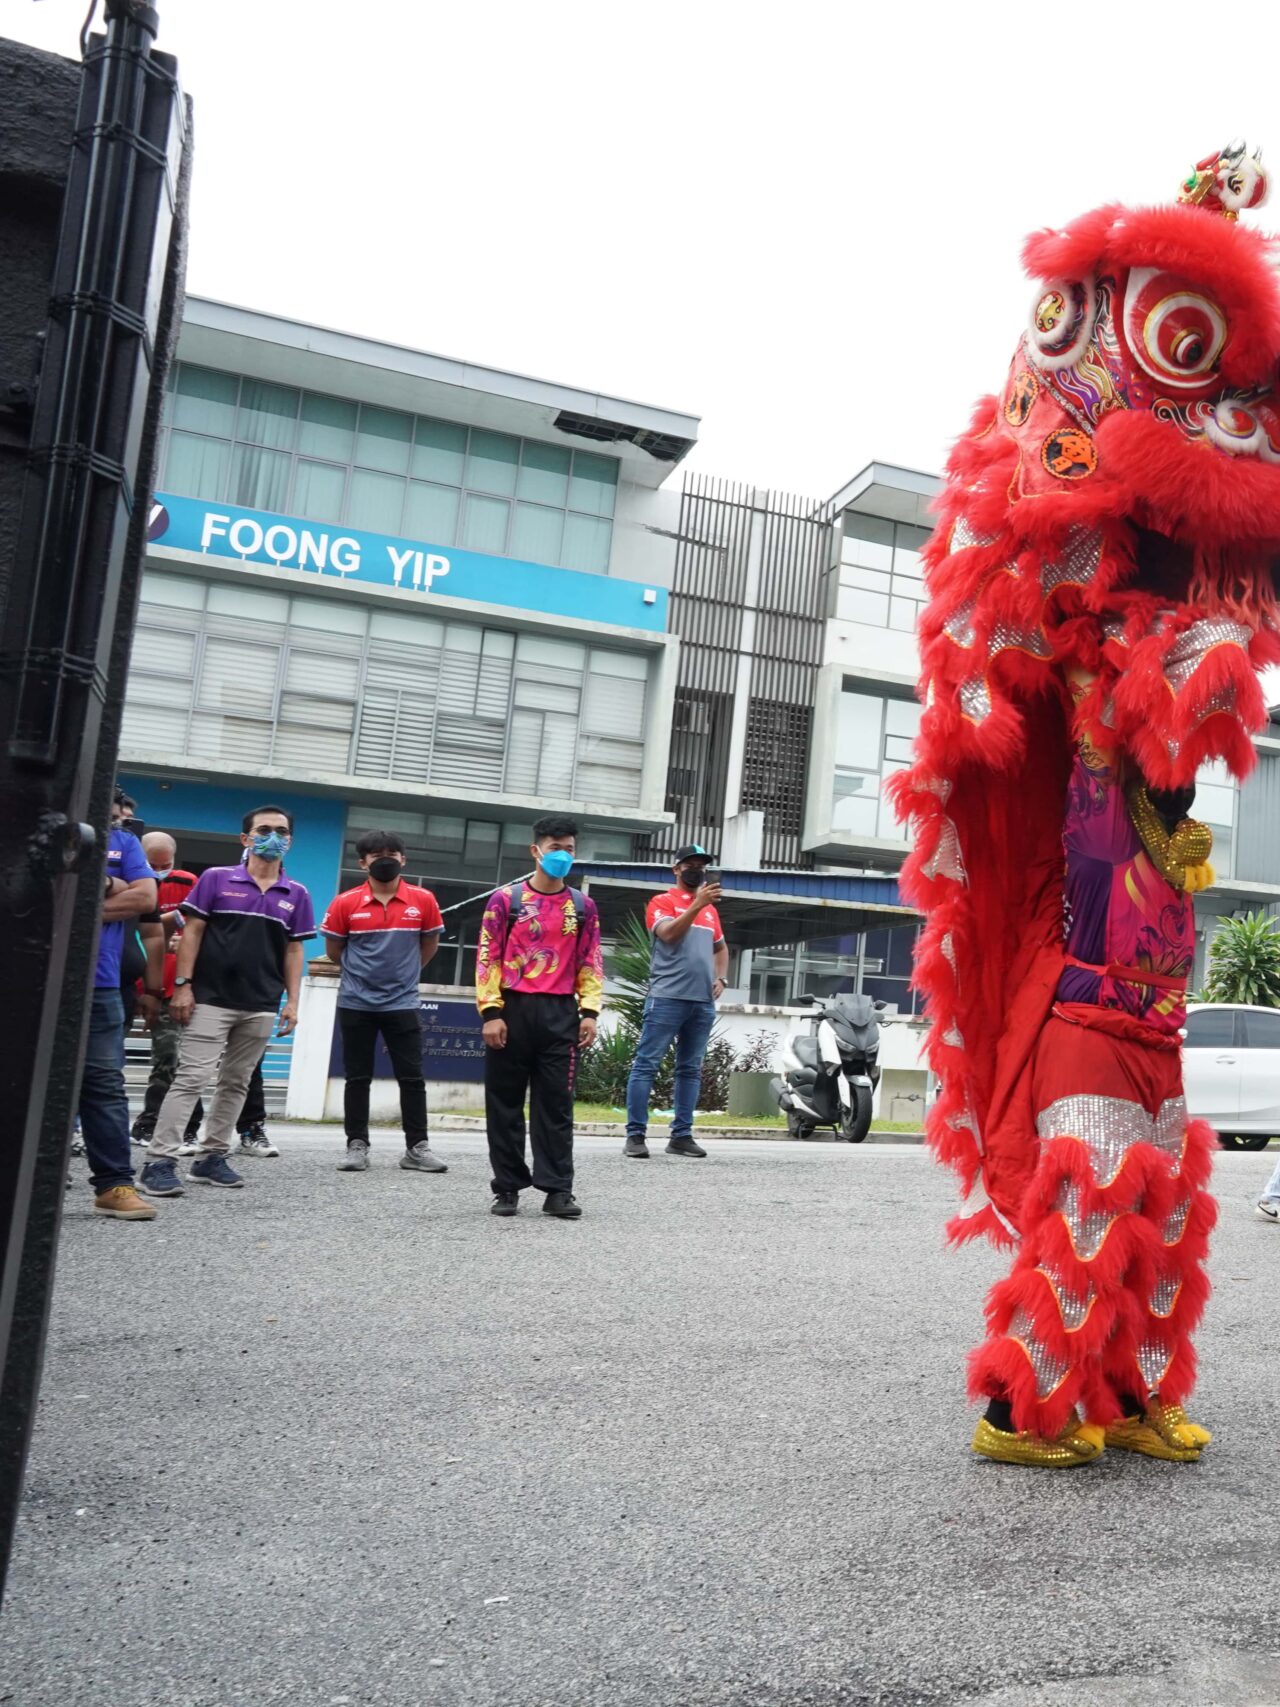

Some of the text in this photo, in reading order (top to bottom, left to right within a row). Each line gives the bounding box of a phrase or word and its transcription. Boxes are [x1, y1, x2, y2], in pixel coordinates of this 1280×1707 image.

[201, 512, 361, 573] FOONG
[386, 545, 450, 587] YIP
[430, 1049, 486, 1057] INTERNATIONA
